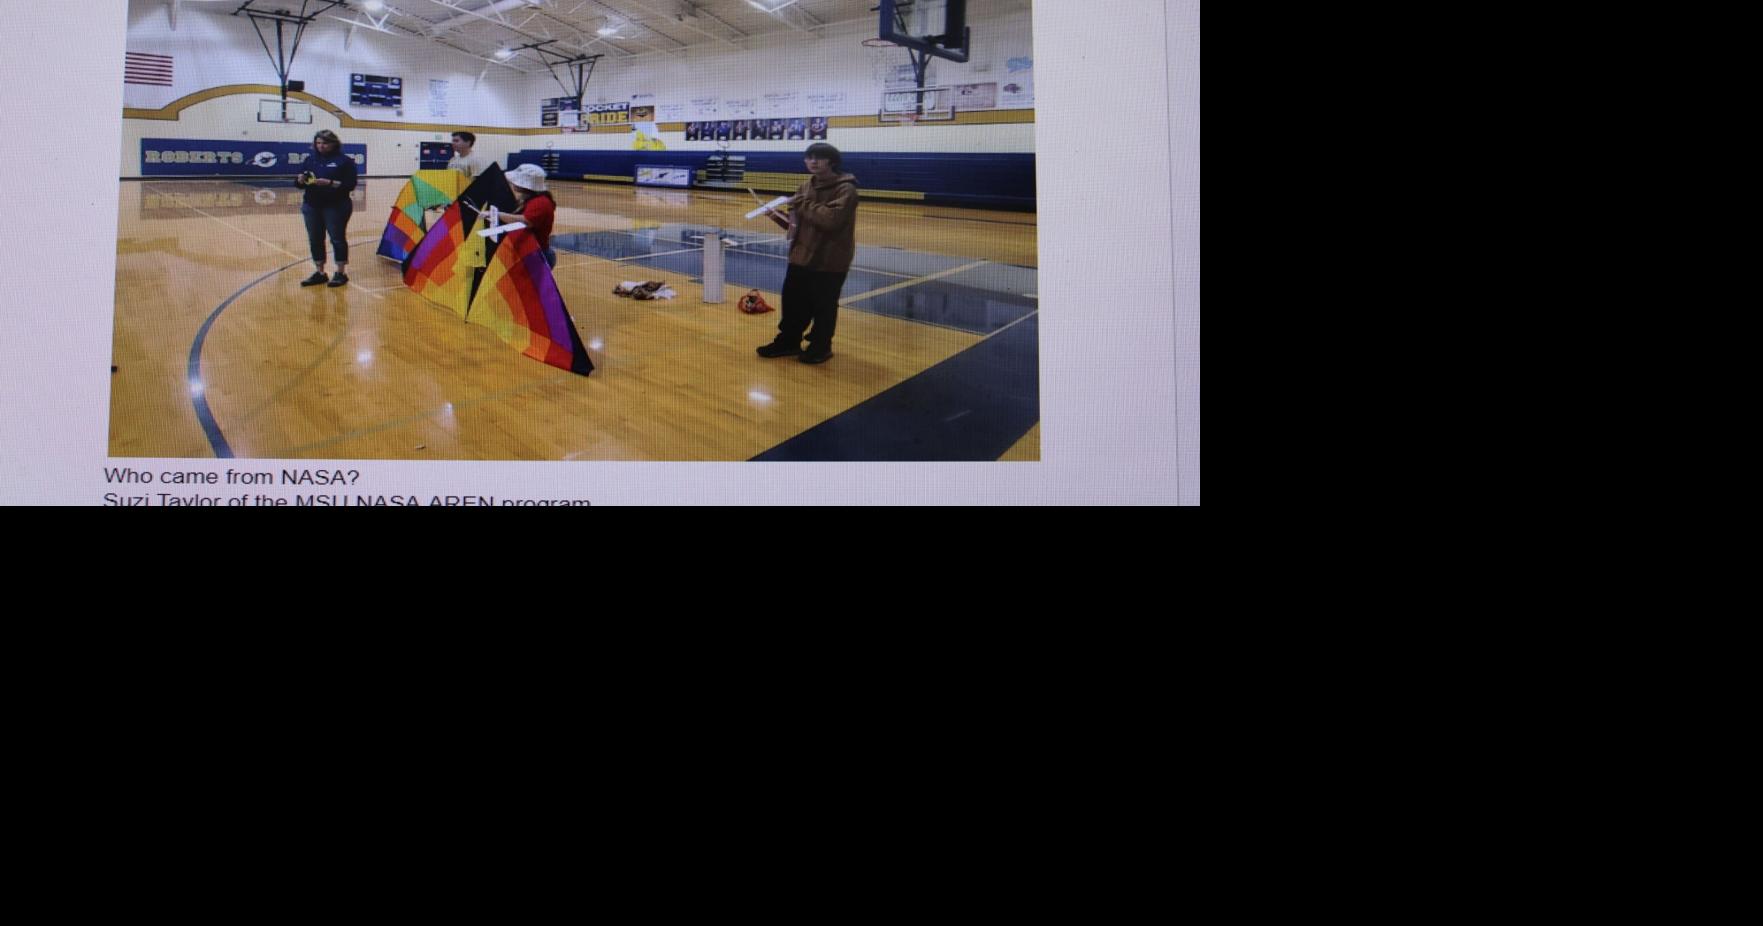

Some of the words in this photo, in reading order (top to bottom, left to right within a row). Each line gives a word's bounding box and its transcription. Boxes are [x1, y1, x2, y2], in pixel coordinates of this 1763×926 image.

[582, 102, 627, 113] OCKET
[145, 150, 244, 164] ROBERTS
[104, 467, 153, 484] Who
[160, 471, 219, 484] came
[226, 468, 273, 485] from
[282, 469, 360, 486] NASA?
[104, 492, 150, 506] Suzi
[157, 493, 223, 506] Taylor
[228, 494, 249, 506] of
[255, 494, 288, 506] the
[357, 495, 419, 506] NASA
[430, 495, 494, 506] AREN
